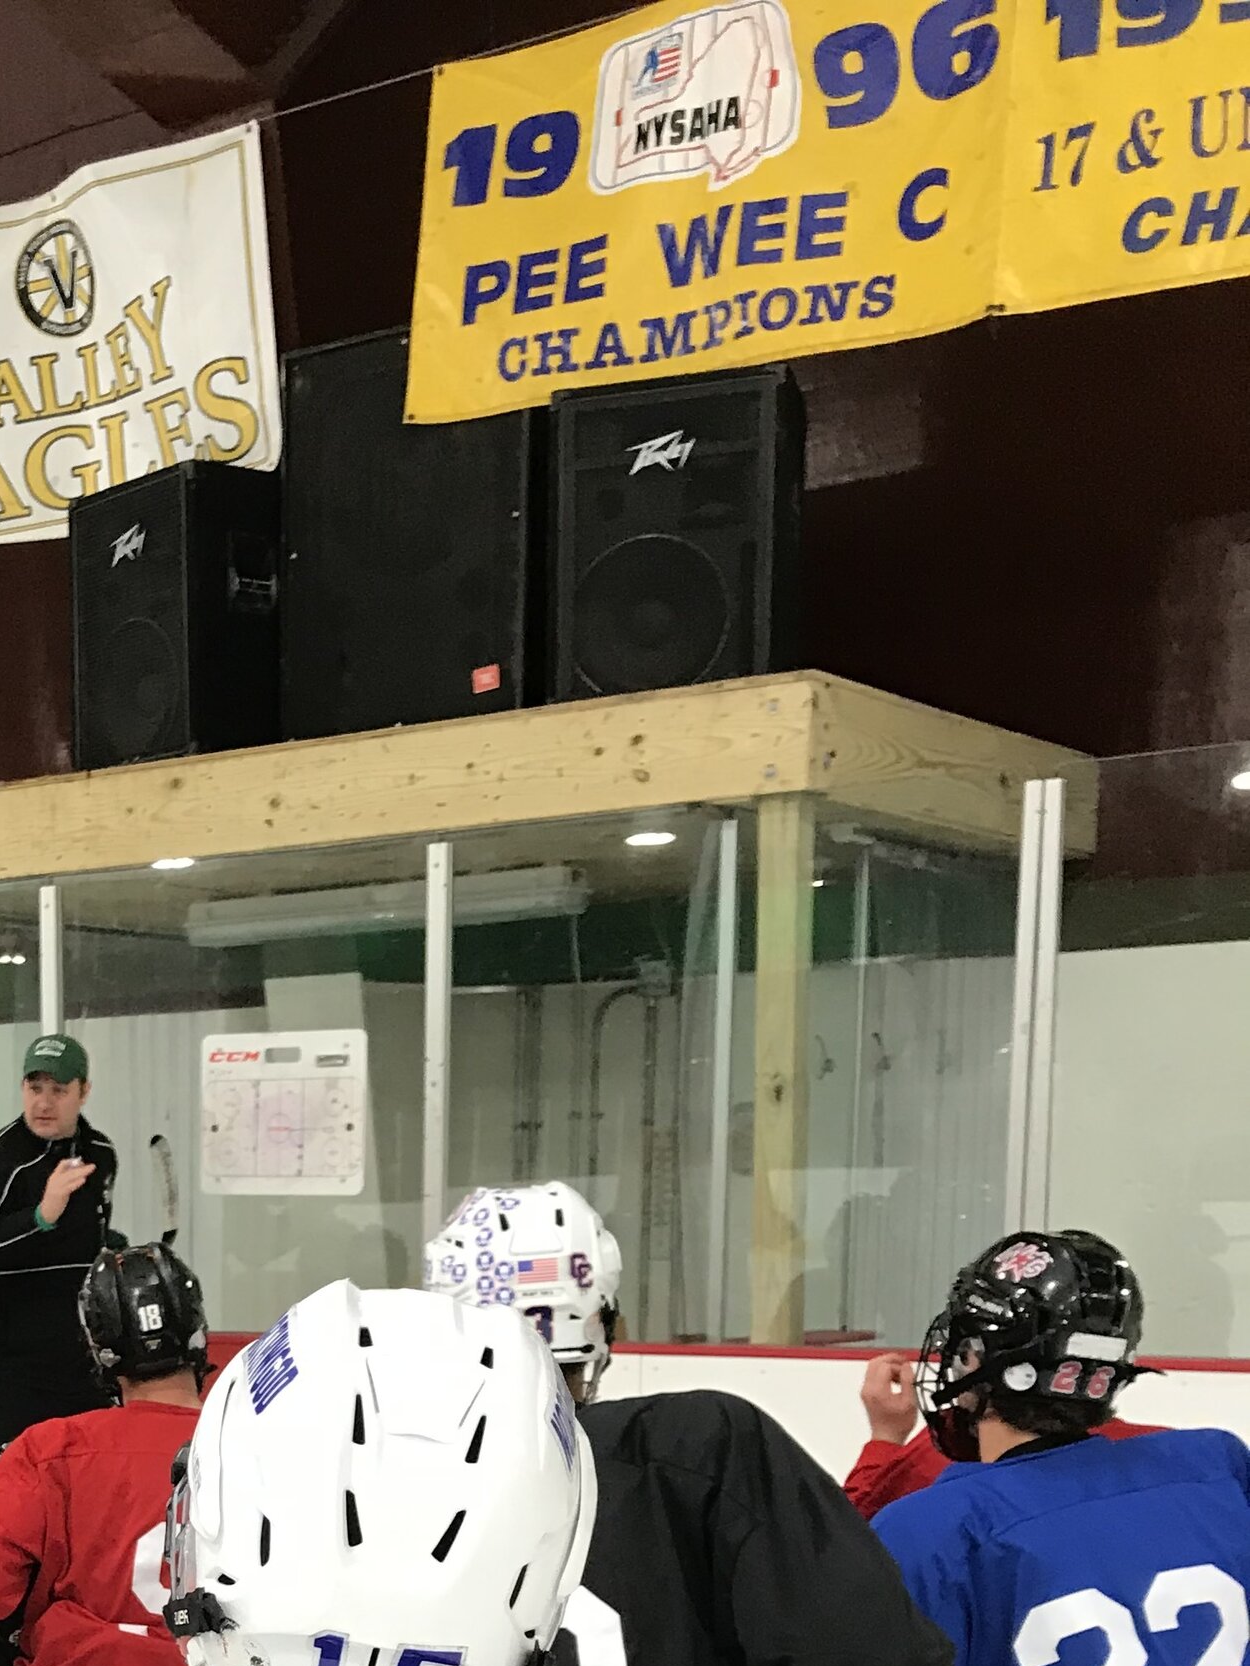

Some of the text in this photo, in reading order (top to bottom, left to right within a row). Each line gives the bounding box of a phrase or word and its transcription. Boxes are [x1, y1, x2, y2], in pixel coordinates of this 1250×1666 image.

[442, 0, 1001, 207] 19 96
[633, 96, 741, 154] NYSAHA
[1032, 121, 1097, 192] 17
[1116, 108, 1165, 174] &
[460, 167, 950, 327] PEE WEE C
[497, 274, 898, 383] CHAMPIONS
[209, 1051, 260, 1063] CCM
[138, 1304, 163, 1332] 18
